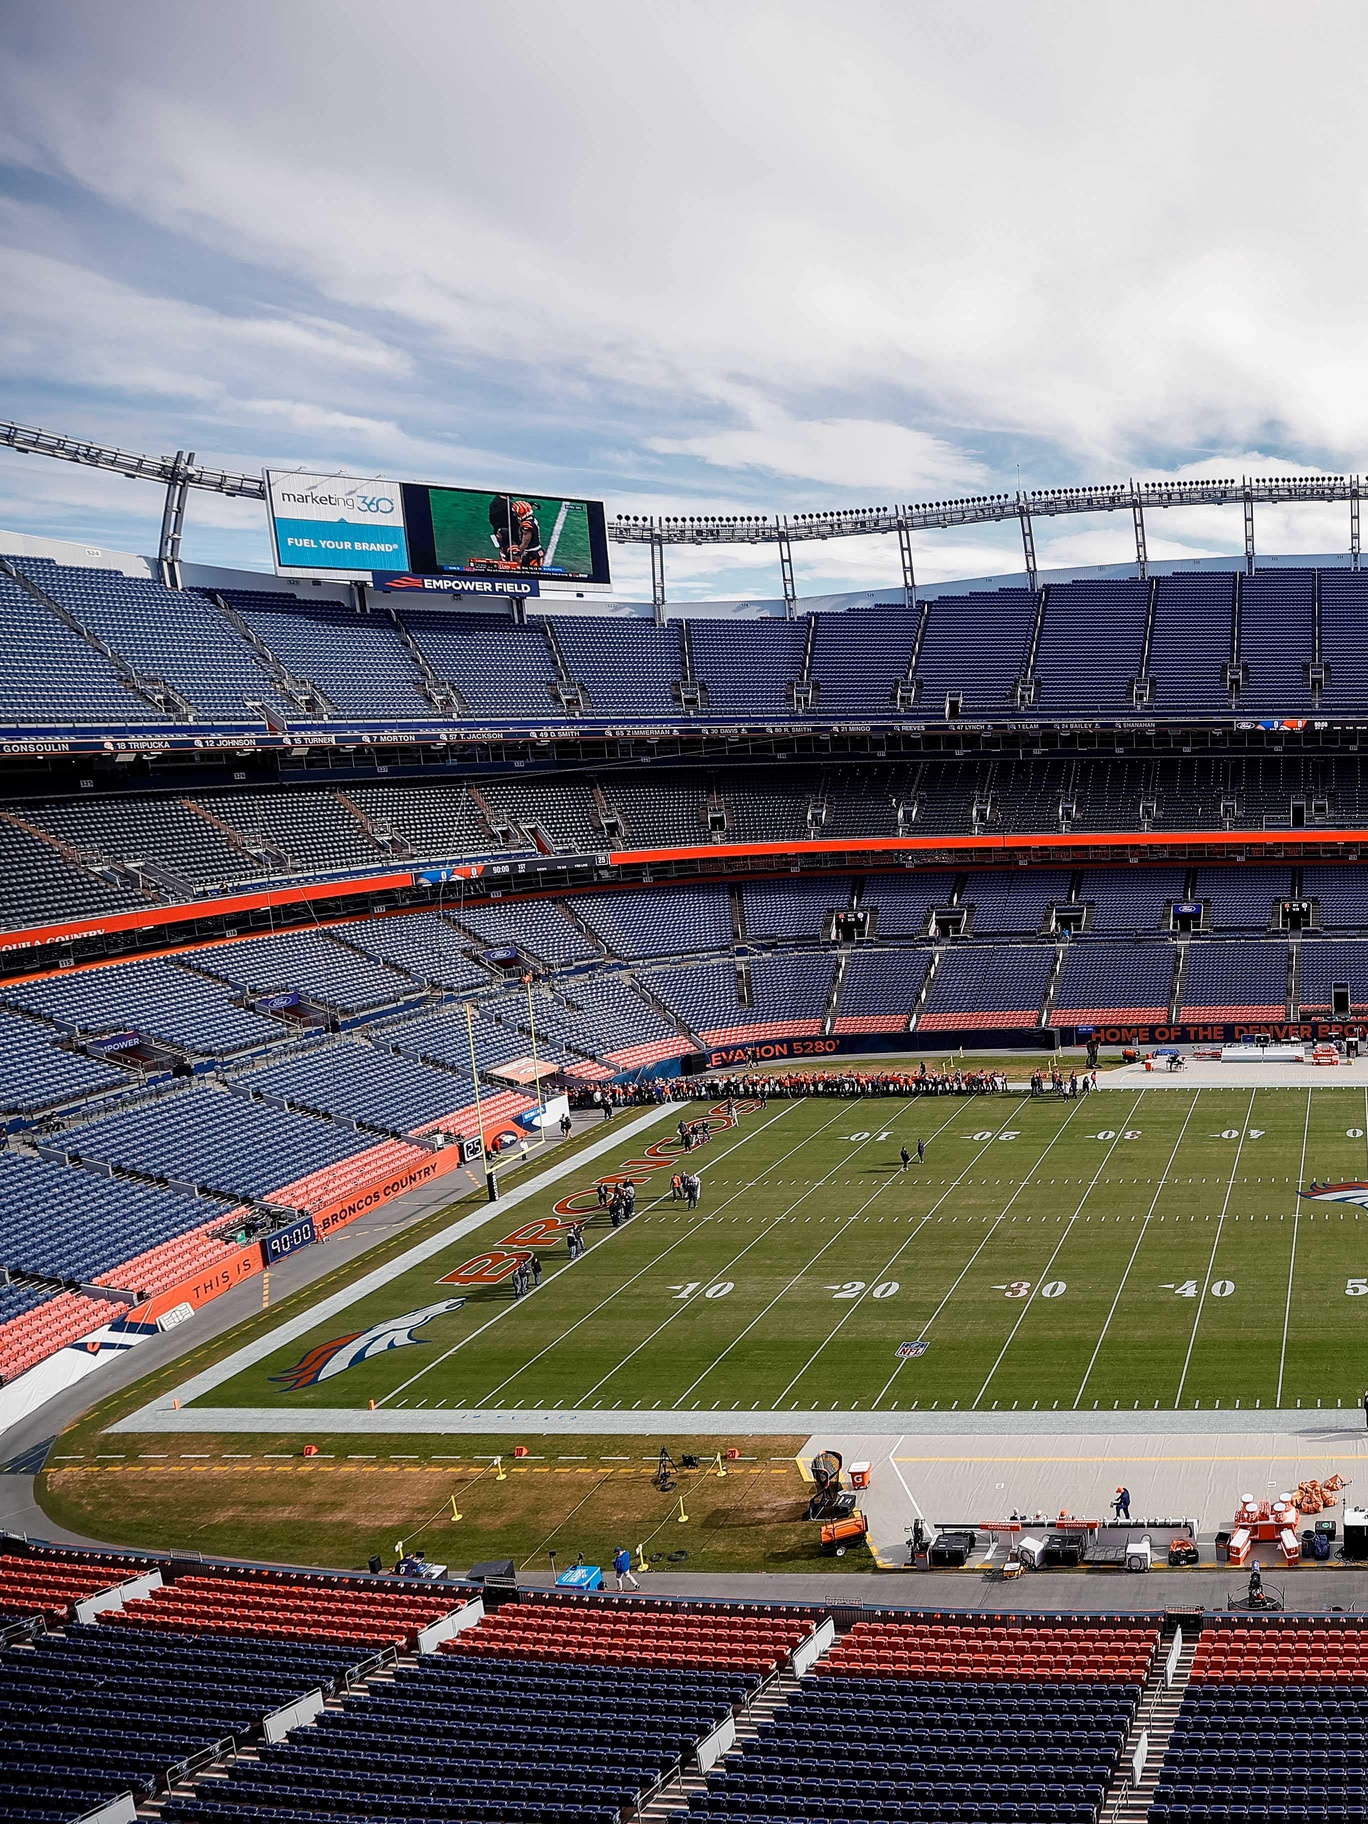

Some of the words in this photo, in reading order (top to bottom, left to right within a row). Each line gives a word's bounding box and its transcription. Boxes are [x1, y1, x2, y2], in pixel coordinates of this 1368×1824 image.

[282, 492, 354, 509] marketing
[357, 495, 394, 514] 360
[287, 537, 317, 548] FUEL
[319, 539, 352, 550] YOUR
[424, 579, 493, 592] EMPOWER
[495, 583, 531, 593] FIELD
[116, 742, 126, 750] 18
[128, 741, 170, 749] TRIPUCKA
[217, 738, 256, 747] JOHNSON
[293, 737, 302, 745] 15
[303, 736, 333, 745] TURNER
[3, 743, 69, 753] GONSOULIN
[441, 870, 447, 879] 0
[471, 867, 477, 876] 0
[492, 865, 509, 874] 90:00
[1091, 1027, 1149, 1043] HOME
[1154, 1026, 1181, 1042] OF
[1198, 1026, 1224, 1041] THE
[850, 1131, 894, 1142] 10
[972, 1130, 1021, 1142] 20
[1096, 1129, 1143, 1141] 30
[1219, 1129, 1266, 1140] 40
[468, 1139, 482, 1157] 25
[322, 1187, 382, 1231] BRONCOS
[383, 1162, 438, 1203] COUNTRY
[435, 1098, 763, 1287] BRONCOS
[270, 1224, 311, 1254] 90:00
[192, 1270, 231, 1300] THIS
[236, 1258, 252, 1280] IS
[671, 1281, 735, 1300] 10
[831, 1281, 900, 1299] 20
[1003, 1280, 1067, 1299] 30
[1173, 1280, 1236, 1298] 40
[900, 1347, 922, 1356] NFL
[727, 1449, 736, 1459] 20
[853, 1474, 862, 1483] G
